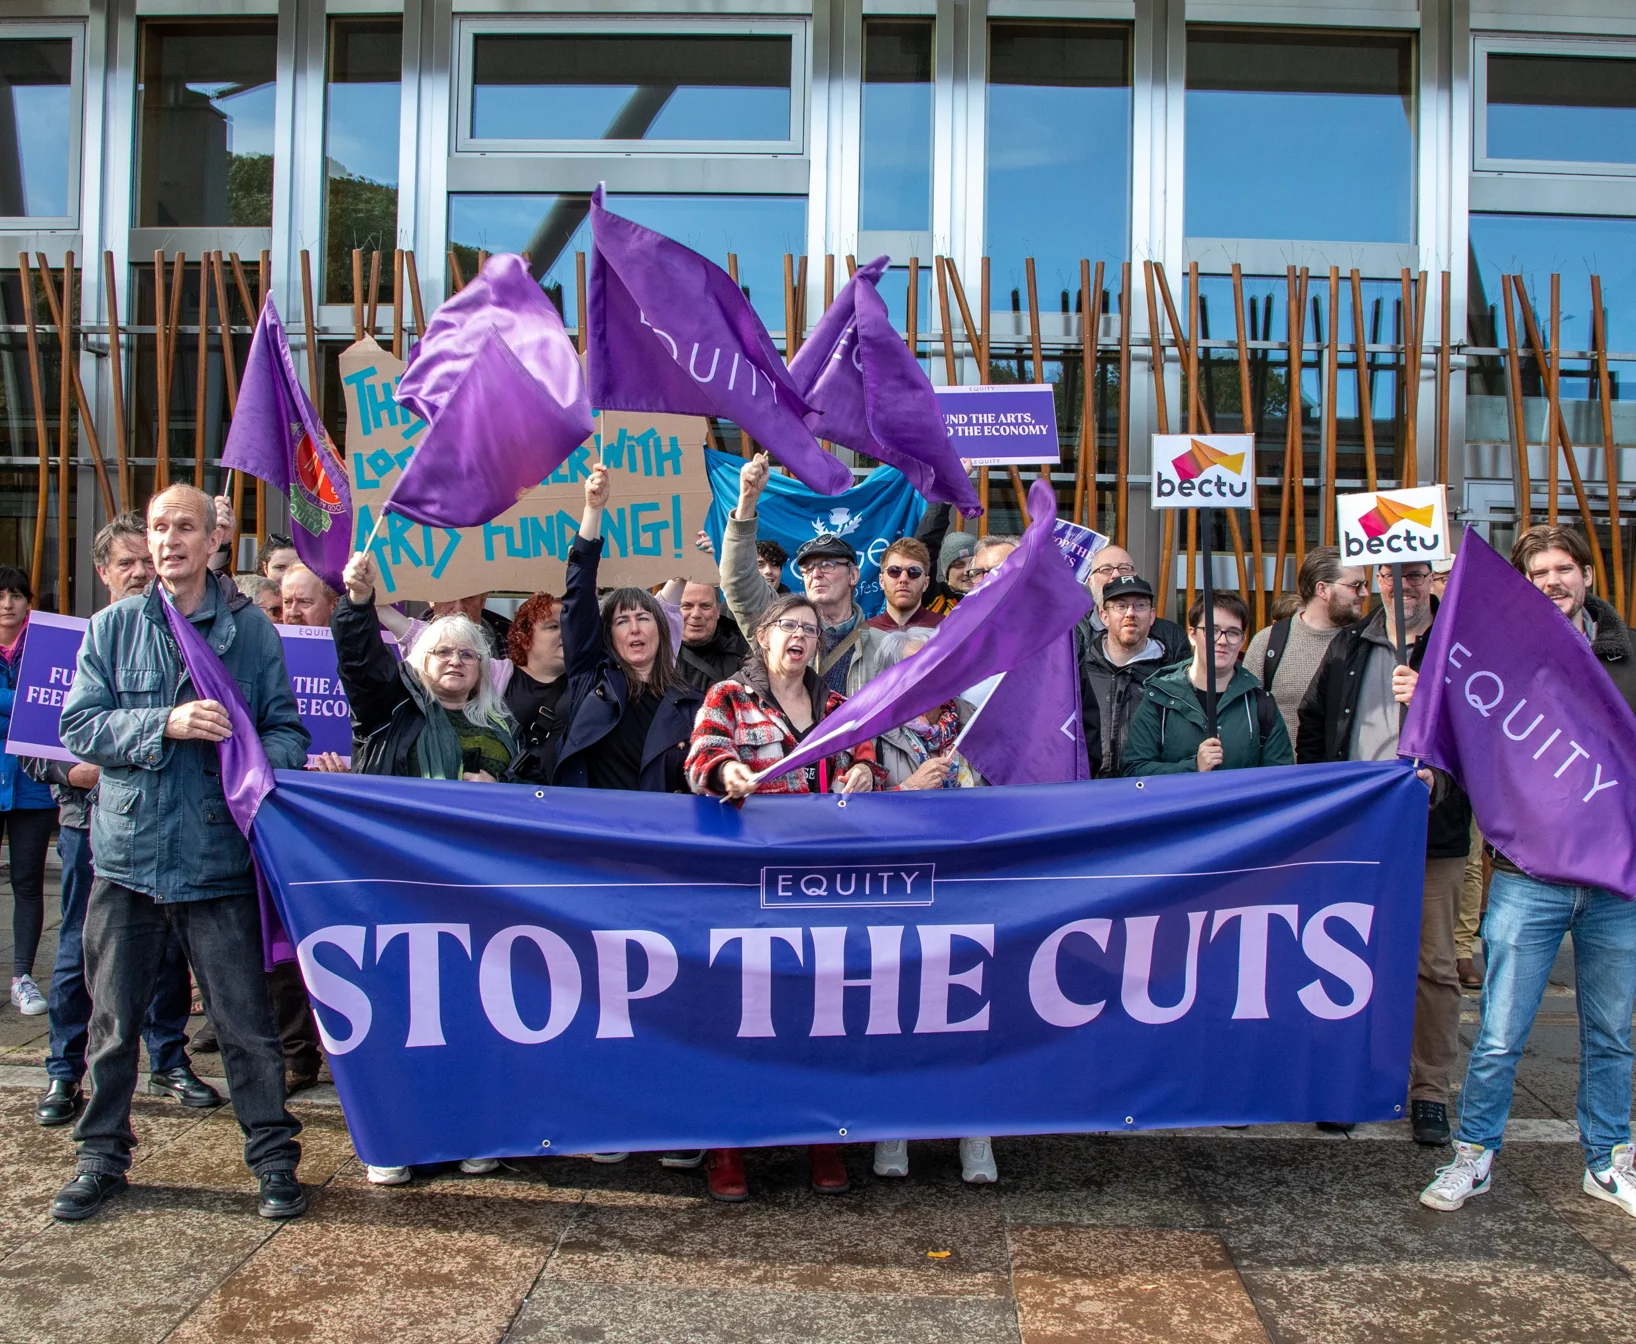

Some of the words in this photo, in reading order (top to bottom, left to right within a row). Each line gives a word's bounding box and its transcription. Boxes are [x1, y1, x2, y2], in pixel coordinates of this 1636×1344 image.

[943, 414, 967, 424] UND
[970, 413, 995, 424] THE
[998, 412, 1035, 425] ARTS,
[955, 426, 981, 437] THE
[984, 424, 1049, 436] ECONOMY
[1157, 470, 1247, 498] bectu
[290, 503, 320, 530] QUITY
[1344, 528, 1439, 558] bectu
[299, 627, 331, 637] EQUIT
[293, 676, 331, 695] THE
[1444, 641, 1619, 803] EQUITY
[777, 870, 921, 898] EQUITY
[296, 922, 678, 1055] STOP
[709, 924, 995, 1038] THE
[1028, 902, 1375, 1028] CUTS
